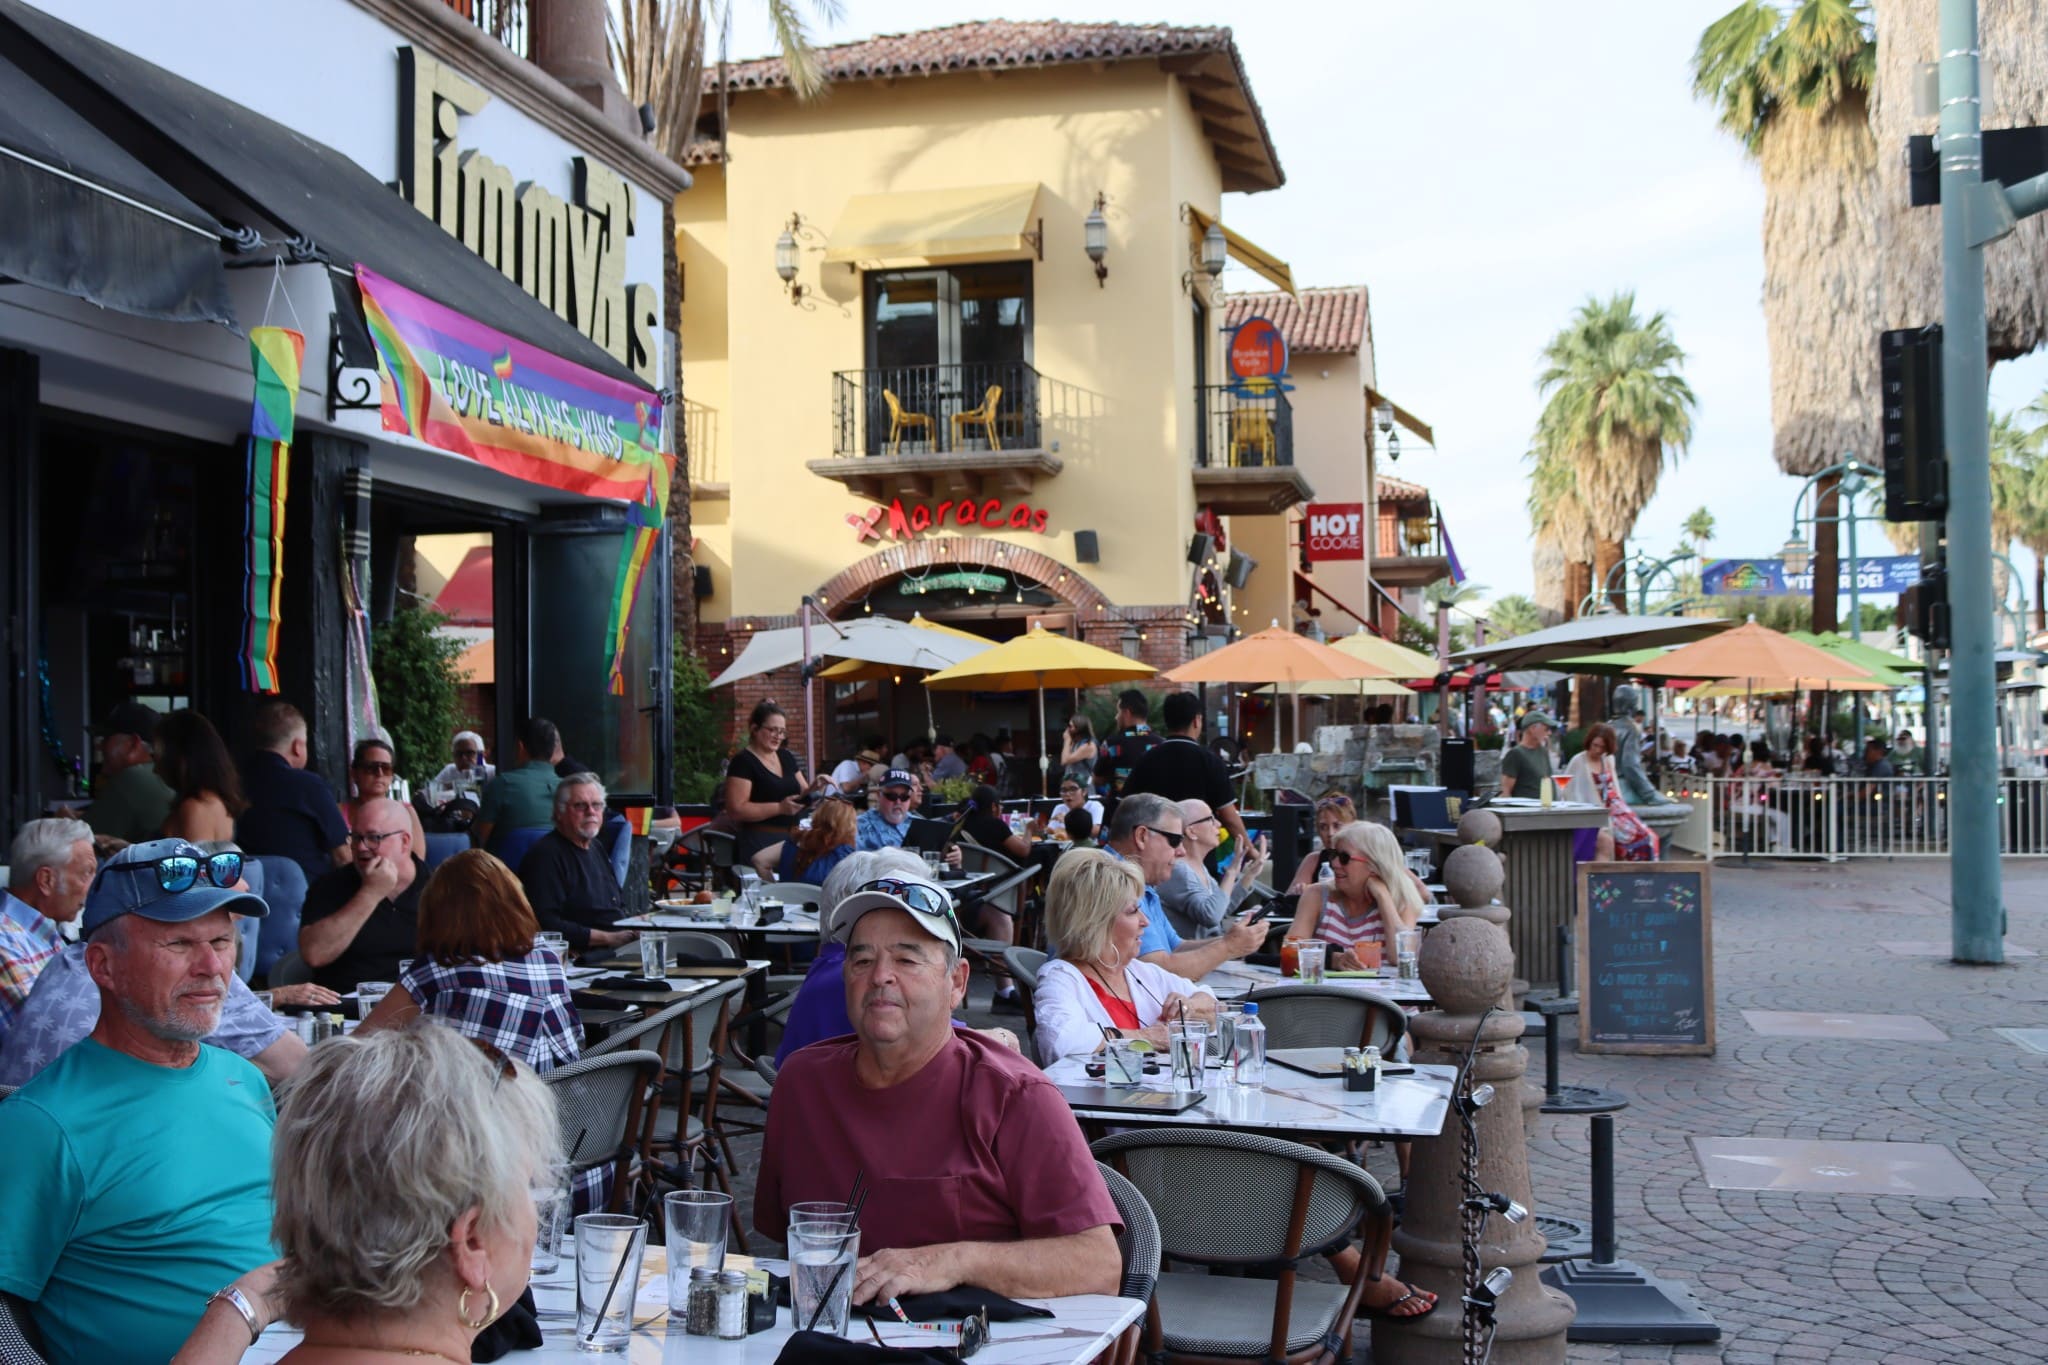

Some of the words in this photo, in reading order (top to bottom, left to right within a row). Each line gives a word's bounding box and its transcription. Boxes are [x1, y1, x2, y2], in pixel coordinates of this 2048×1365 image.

[438, 355, 504, 427] LOVE
[501, 383, 582, 450] ALWAYS
[575, 408, 624, 462] WINS
[888, 497, 1049, 539] Maracas
[1310, 514, 1361, 536] HOT
[1310, 537, 1361, 551] COOKIE
